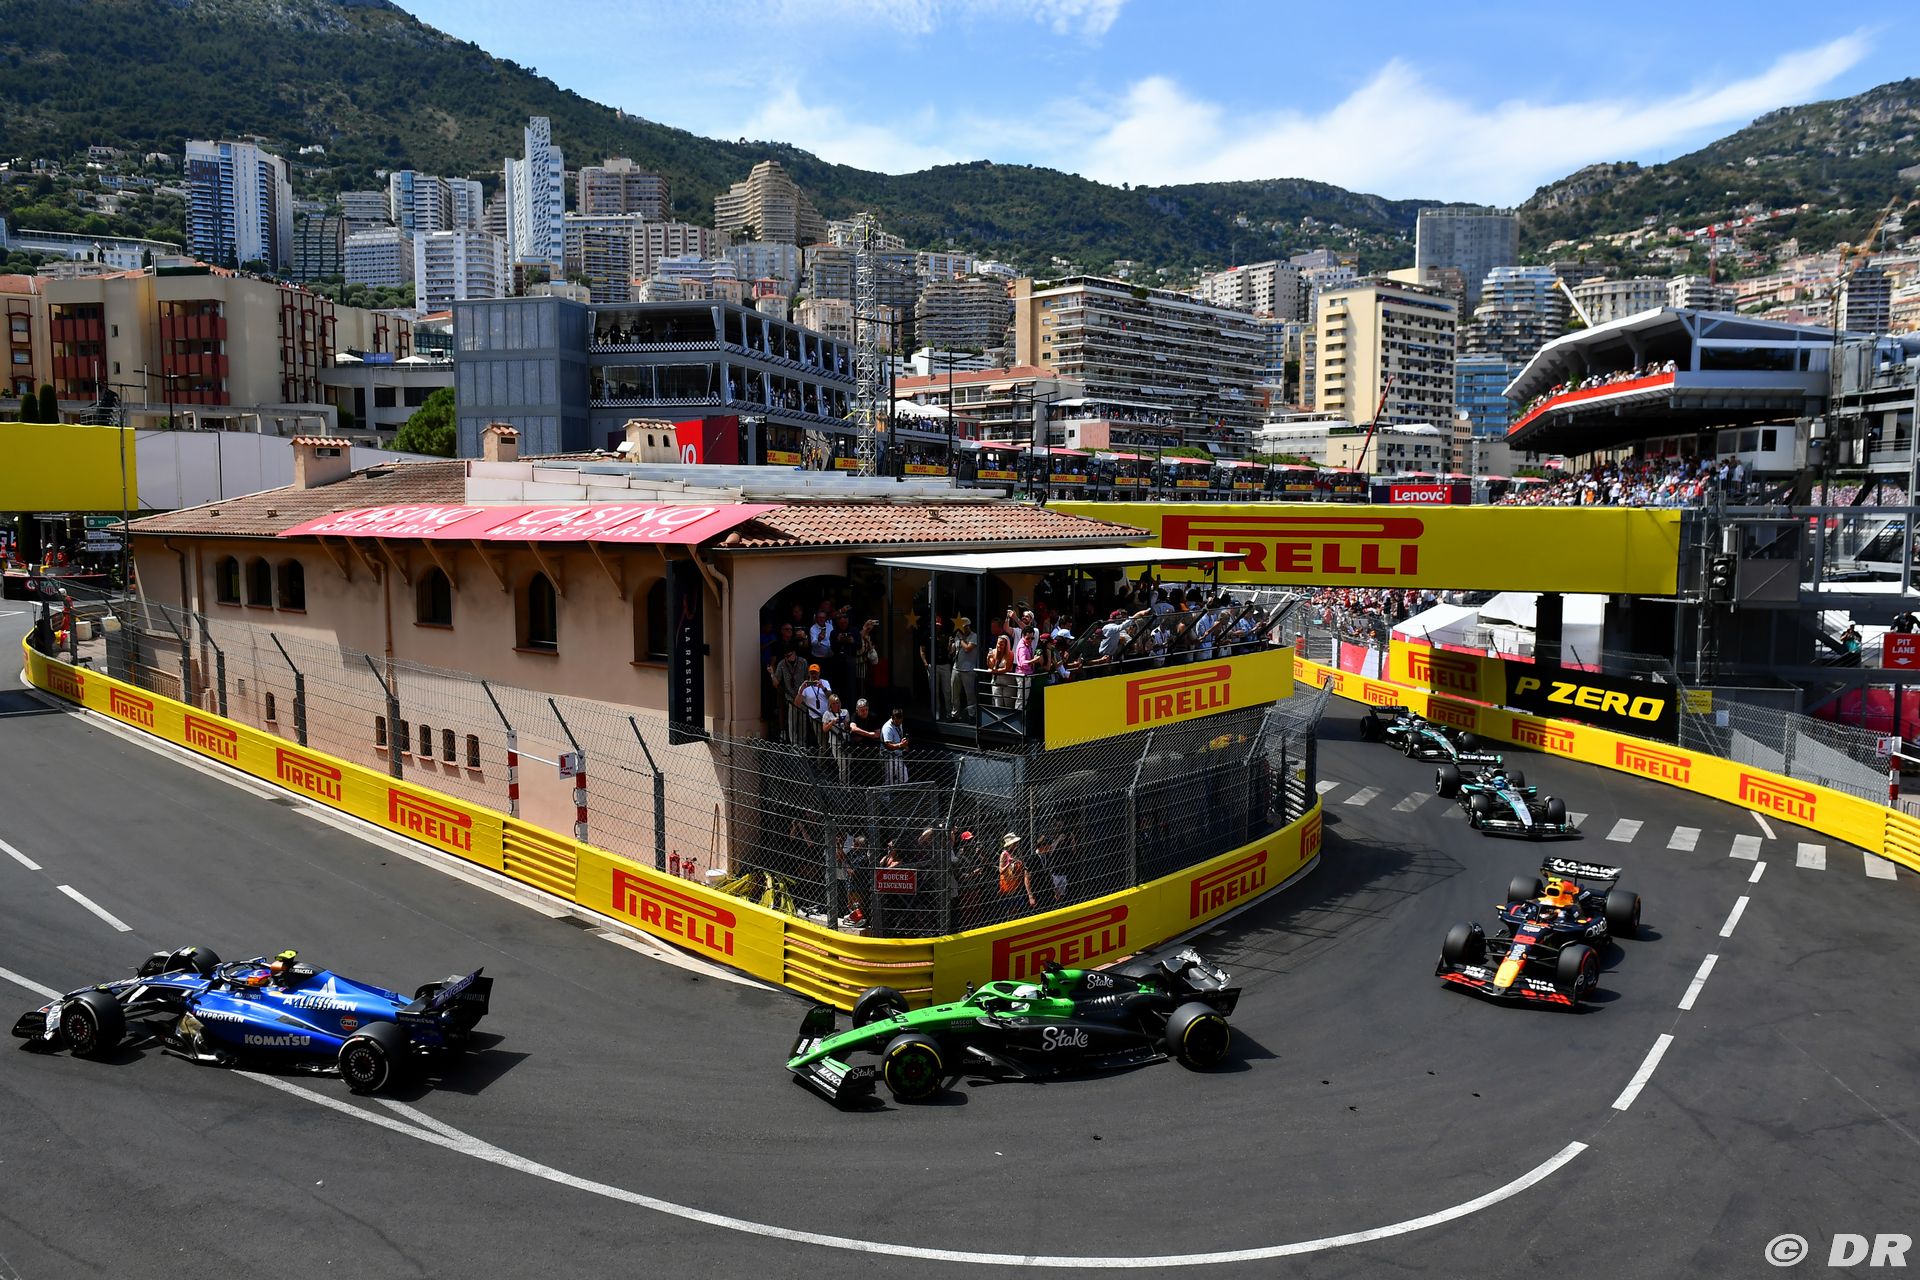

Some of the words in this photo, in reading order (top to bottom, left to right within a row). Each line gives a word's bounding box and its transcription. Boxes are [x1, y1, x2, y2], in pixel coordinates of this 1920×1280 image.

[1394, 489, 1446, 501] Lenovo
[336, 507, 485, 525] CASINO
[518, 506, 716, 527] CASINO
[1161, 515, 1425, 575] PIRELLI
[684, 627, 691, 642] LA
[1892, 646, 1916, 654] LANE
[1897, 638, 1911, 646] PIT
[47, 663, 85, 700] PIRELLI
[1408, 650, 1478, 693] PIRELLI
[110, 687, 154, 728] PIRELLI
[1126, 664, 1232, 726] PIRELLI
[1363, 682, 1399, 707] PIRELLI
[1514, 676, 1541, 695] P
[1547, 681, 1665, 722] ZERO
[1427, 698, 1476, 730] PIRELLI
[184, 713, 238, 760] PIRELLI
[1511, 718, 1574, 754] PIRELLI
[276, 747, 342, 801] PIRELLI
[1616, 741, 1691, 784] PIRELLI
[1738, 773, 1817, 823] PIRELLI
[388, 787, 473, 851] PIRELLI
[1190, 849, 1268, 920] PIRELLI
[612, 867, 736, 957] PIRELLI
[992, 904, 1128, 982] PIRELLI
[1086, 973, 1114, 990] Stake
[196, 1010, 245, 1024] MYPROTEIN
[341, 1018, 358, 1027] Gulf
[244, 1033, 311, 1047] KOMATSU
[1041, 1026, 1089, 1052] Stake
[851, 1066, 875, 1080] Stake
